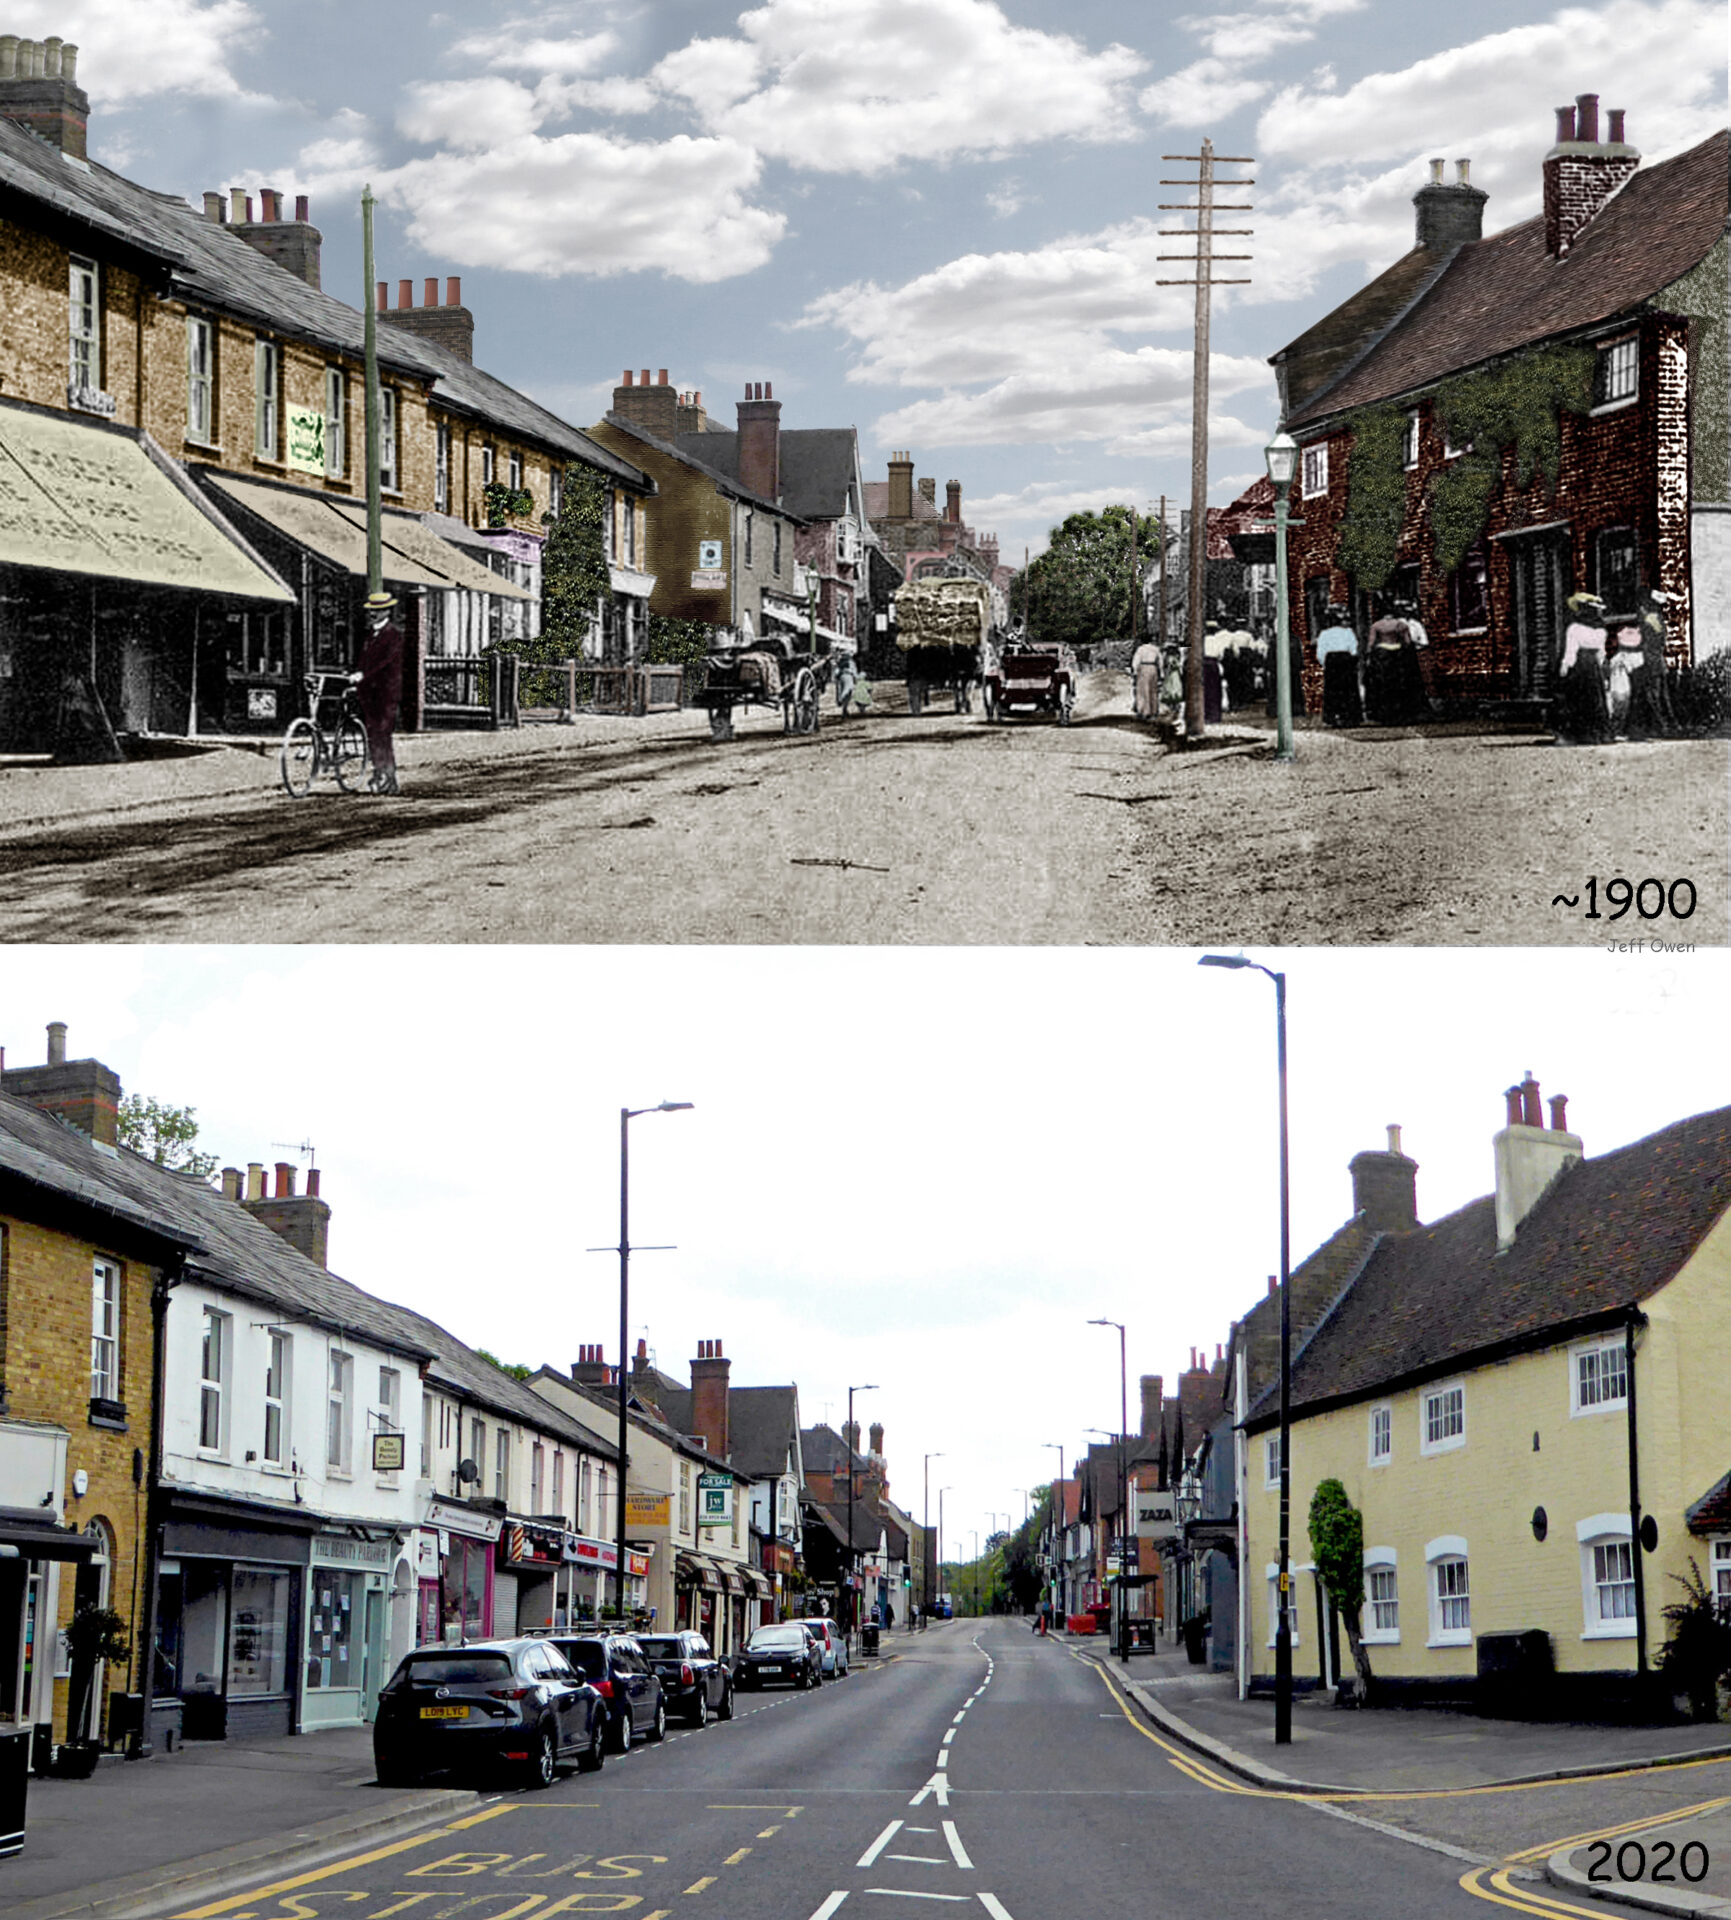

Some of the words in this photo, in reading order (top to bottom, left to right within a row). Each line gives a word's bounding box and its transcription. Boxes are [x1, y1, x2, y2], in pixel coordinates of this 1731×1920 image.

[1139, 1508, 1173, 1522] ZAZA
[315, 1539, 329, 1557] THE
[331, 1541, 356, 1561] BEAUTY
[446, 1706, 464, 1716] LYC
[404, 1852, 669, 1880] BUS
[232, 1890, 646, 1920] STOP
